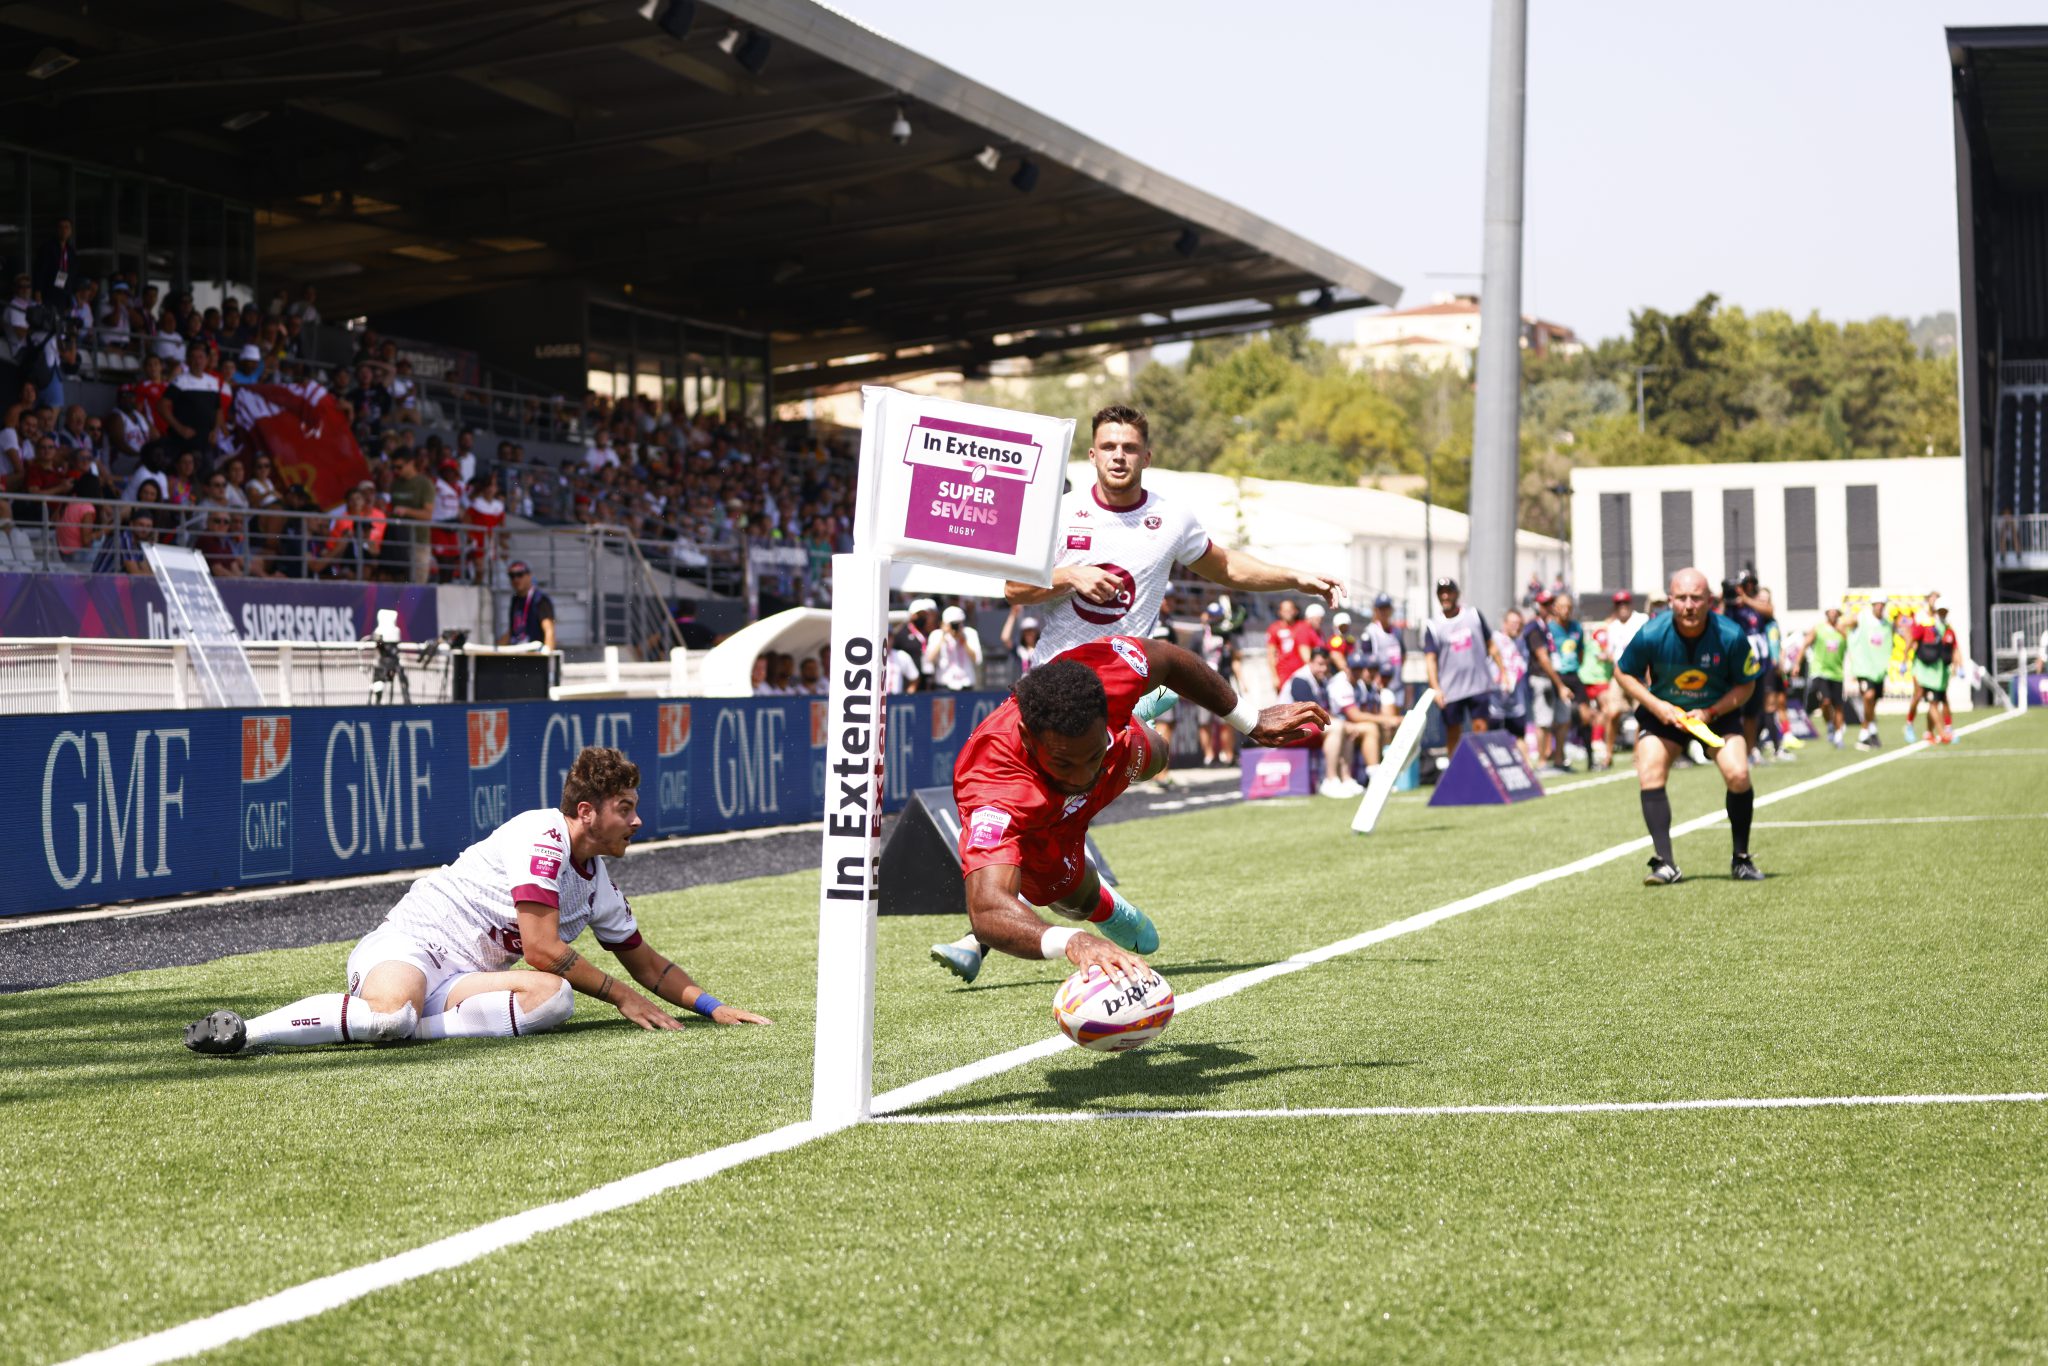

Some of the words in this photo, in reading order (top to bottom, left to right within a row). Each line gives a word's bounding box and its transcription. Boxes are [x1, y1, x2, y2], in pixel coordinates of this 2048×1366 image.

[923, 432, 941, 452] In
[946, 436, 1022, 465] Extenso
[930, 497, 998, 526] SEVENS
[938, 480, 995, 505] SUPER
[948, 524, 976, 537] RUGBY
[242, 602, 356, 641] SUPERSEVENS
[828, 637, 873, 838] Extenso
[713, 707, 787, 819] GMF
[41, 728, 190, 890] GMF
[323, 719, 435, 860] GMF
[474, 784, 507, 830] GMF
[659, 770, 689, 813] GMF
[245, 801, 289, 851] GMF
[826, 856, 865, 901] In
